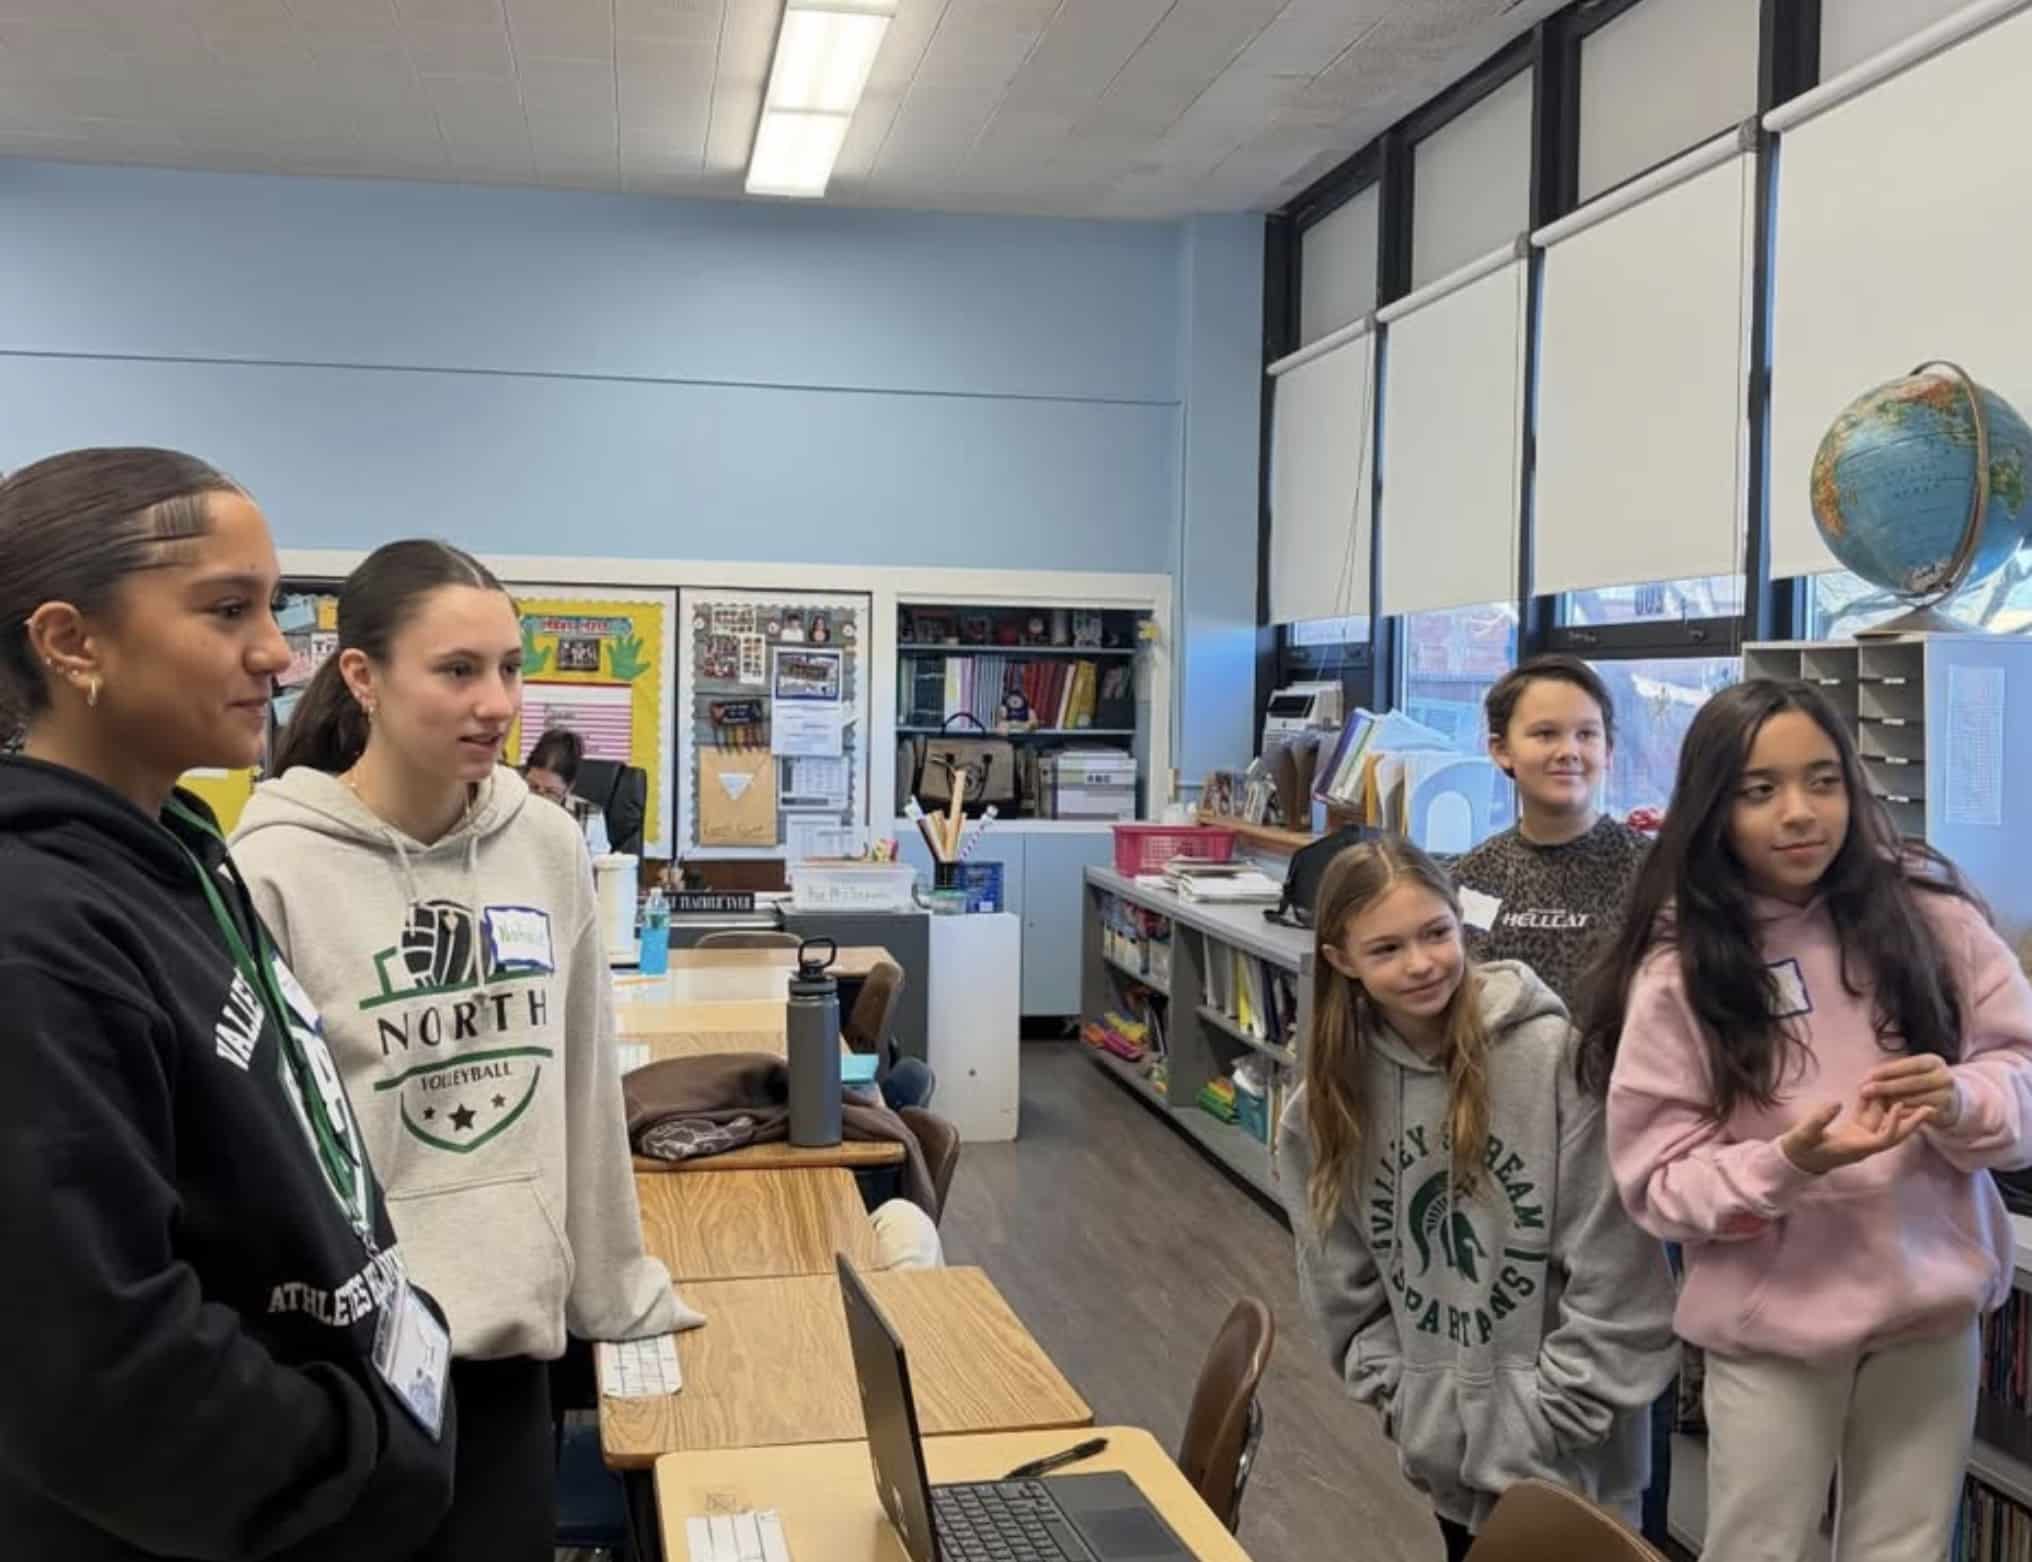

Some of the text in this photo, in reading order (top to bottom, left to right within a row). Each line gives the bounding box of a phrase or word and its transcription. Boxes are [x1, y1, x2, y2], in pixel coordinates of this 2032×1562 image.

[1501, 911, 1591, 928] HELLCAT
[376, 988, 548, 1056] NORTH
[420, 1061, 513, 1091] VOLLEYBALL
